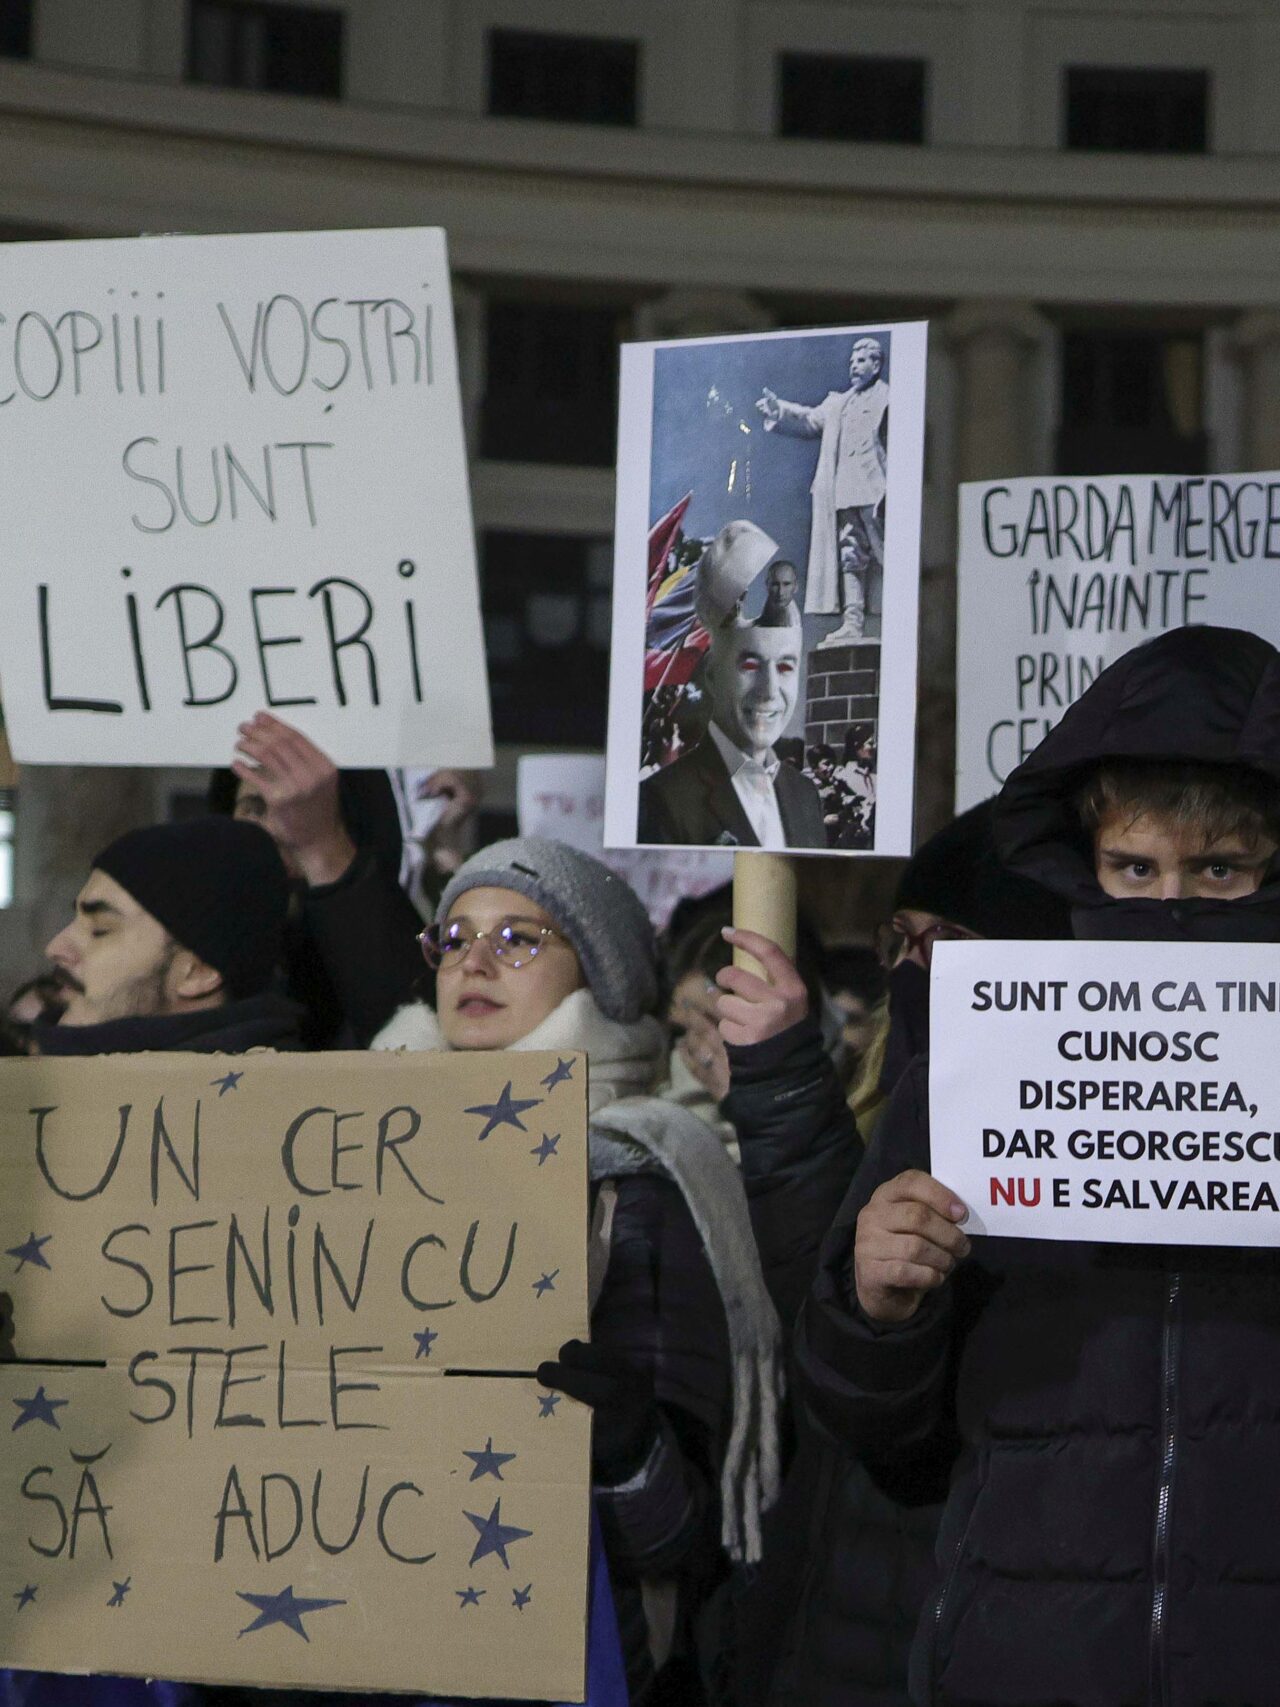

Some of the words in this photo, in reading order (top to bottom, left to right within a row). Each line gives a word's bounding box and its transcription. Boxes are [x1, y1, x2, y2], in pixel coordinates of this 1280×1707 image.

[121, 436, 335, 534] SUNT
[981, 483, 1137, 565] GARDA
[971, 981, 1068, 1013] SUNT
[1078, 981, 1140, 1012] OM
[1151, 981, 1206, 1013] CA
[1057, 1030, 1220, 1062] CUNOSC
[1019, 1079, 1259, 1118] DISPERAREA,
[28, 1095, 201, 1207] UN
[280, 1105, 445, 1205] CER
[982, 1129, 1058, 1159] DAR
[989, 1176, 1041, 1208] NU
[1052, 1179, 1070, 1208] E
[400, 1218, 519, 1312] CU
[128, 1339, 390, 1439] STELE
[20, 1442, 114, 1561] SĂ
[213, 1464, 437, 1564] ADUC
